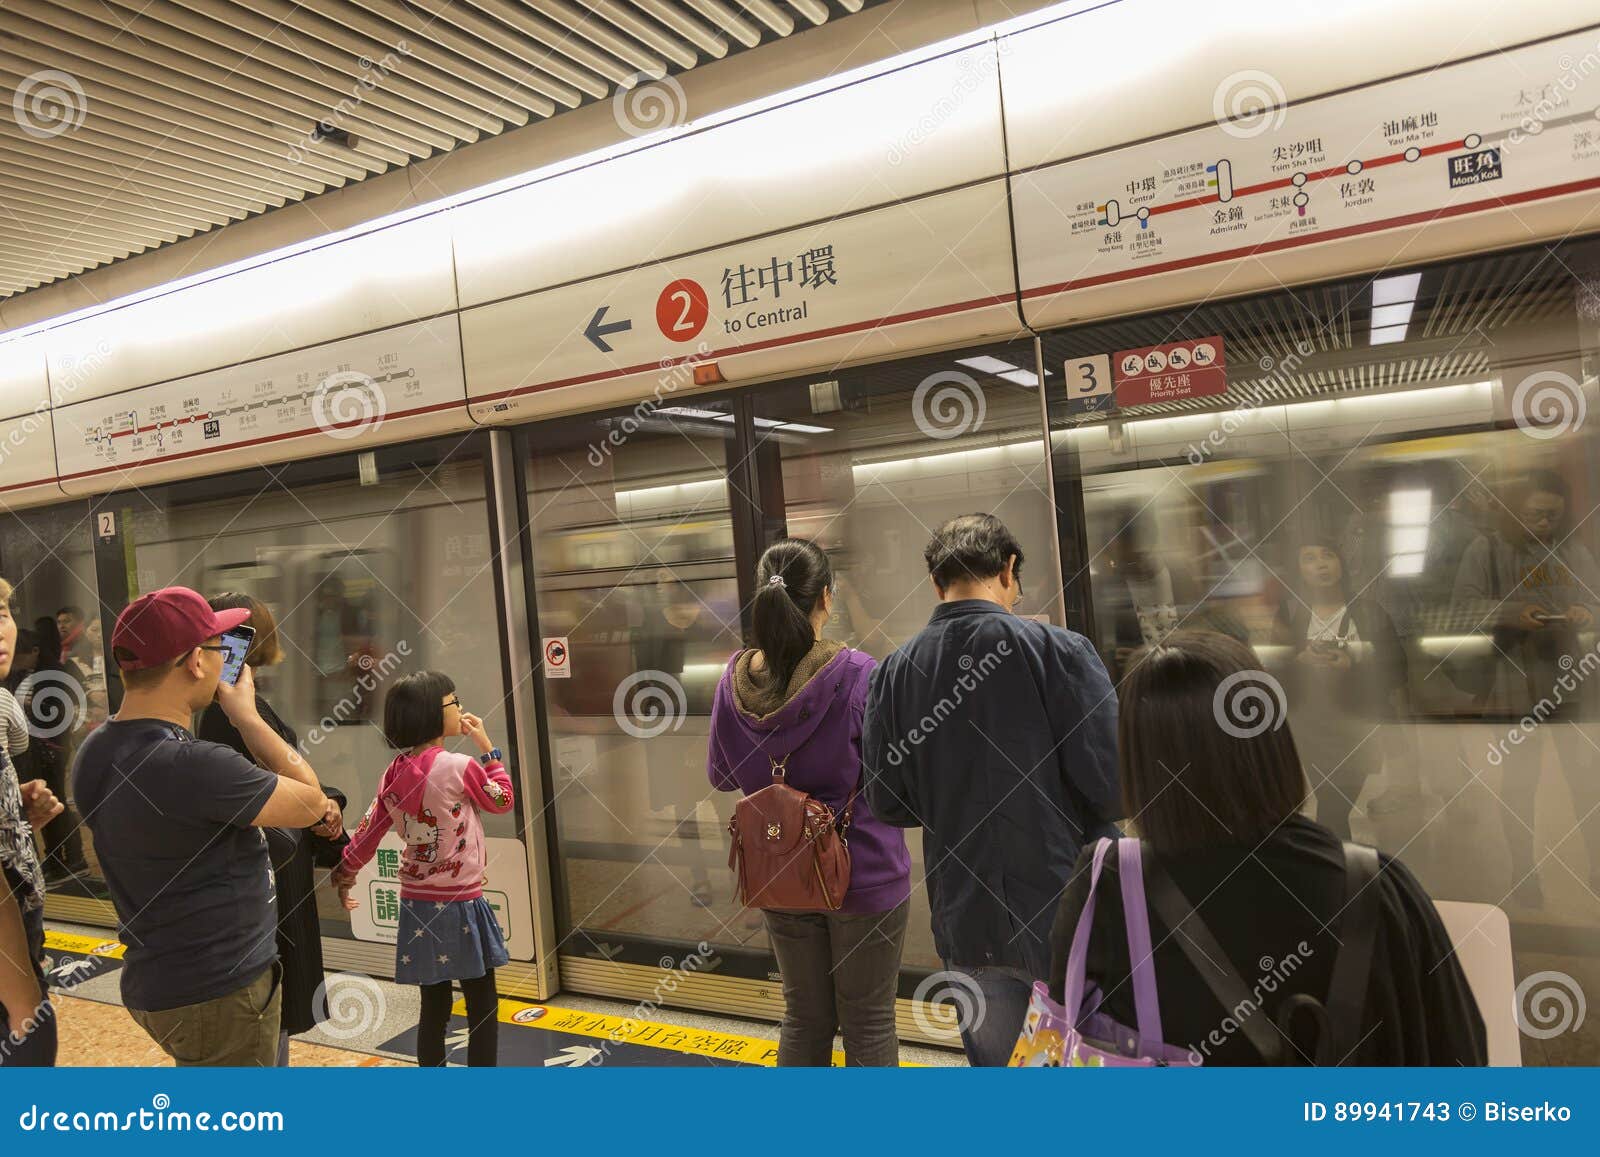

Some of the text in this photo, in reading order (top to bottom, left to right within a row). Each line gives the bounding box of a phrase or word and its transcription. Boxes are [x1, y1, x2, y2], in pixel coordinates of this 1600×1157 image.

[1383, 111, 1438, 137] 油麻地
[1388, 130, 1434, 146] Yau Ma Tei
[1272, 138, 1323, 162] 尖沙咀
[1272, 155, 1325, 172] Tsim Sha Tsui
[1454, 152, 1494, 174] 旺角
[1126, 176, 1156, 195] 中環
[1452, 170, 1499, 186] Mong Kok
[1340, 178, 1375, 199] 佐敦
[1129, 193, 1155, 204] Central
[1344, 196, 1373, 208] Jordan
[1214, 206, 1244, 224] 金鐘
[1210, 222, 1248, 235] Admiralty
[1104, 231, 1122, 245] 香港
[720, 244, 837, 309] 往中環
[670, 290, 694, 331] 2
[724, 301, 807, 334] to Central
[1078, 363, 1097, 392] 3
[1150, 374, 1191, 391] 優先座
[1150, 386, 1191, 399] Priority Seat
[103, 516, 111, 533] 2
